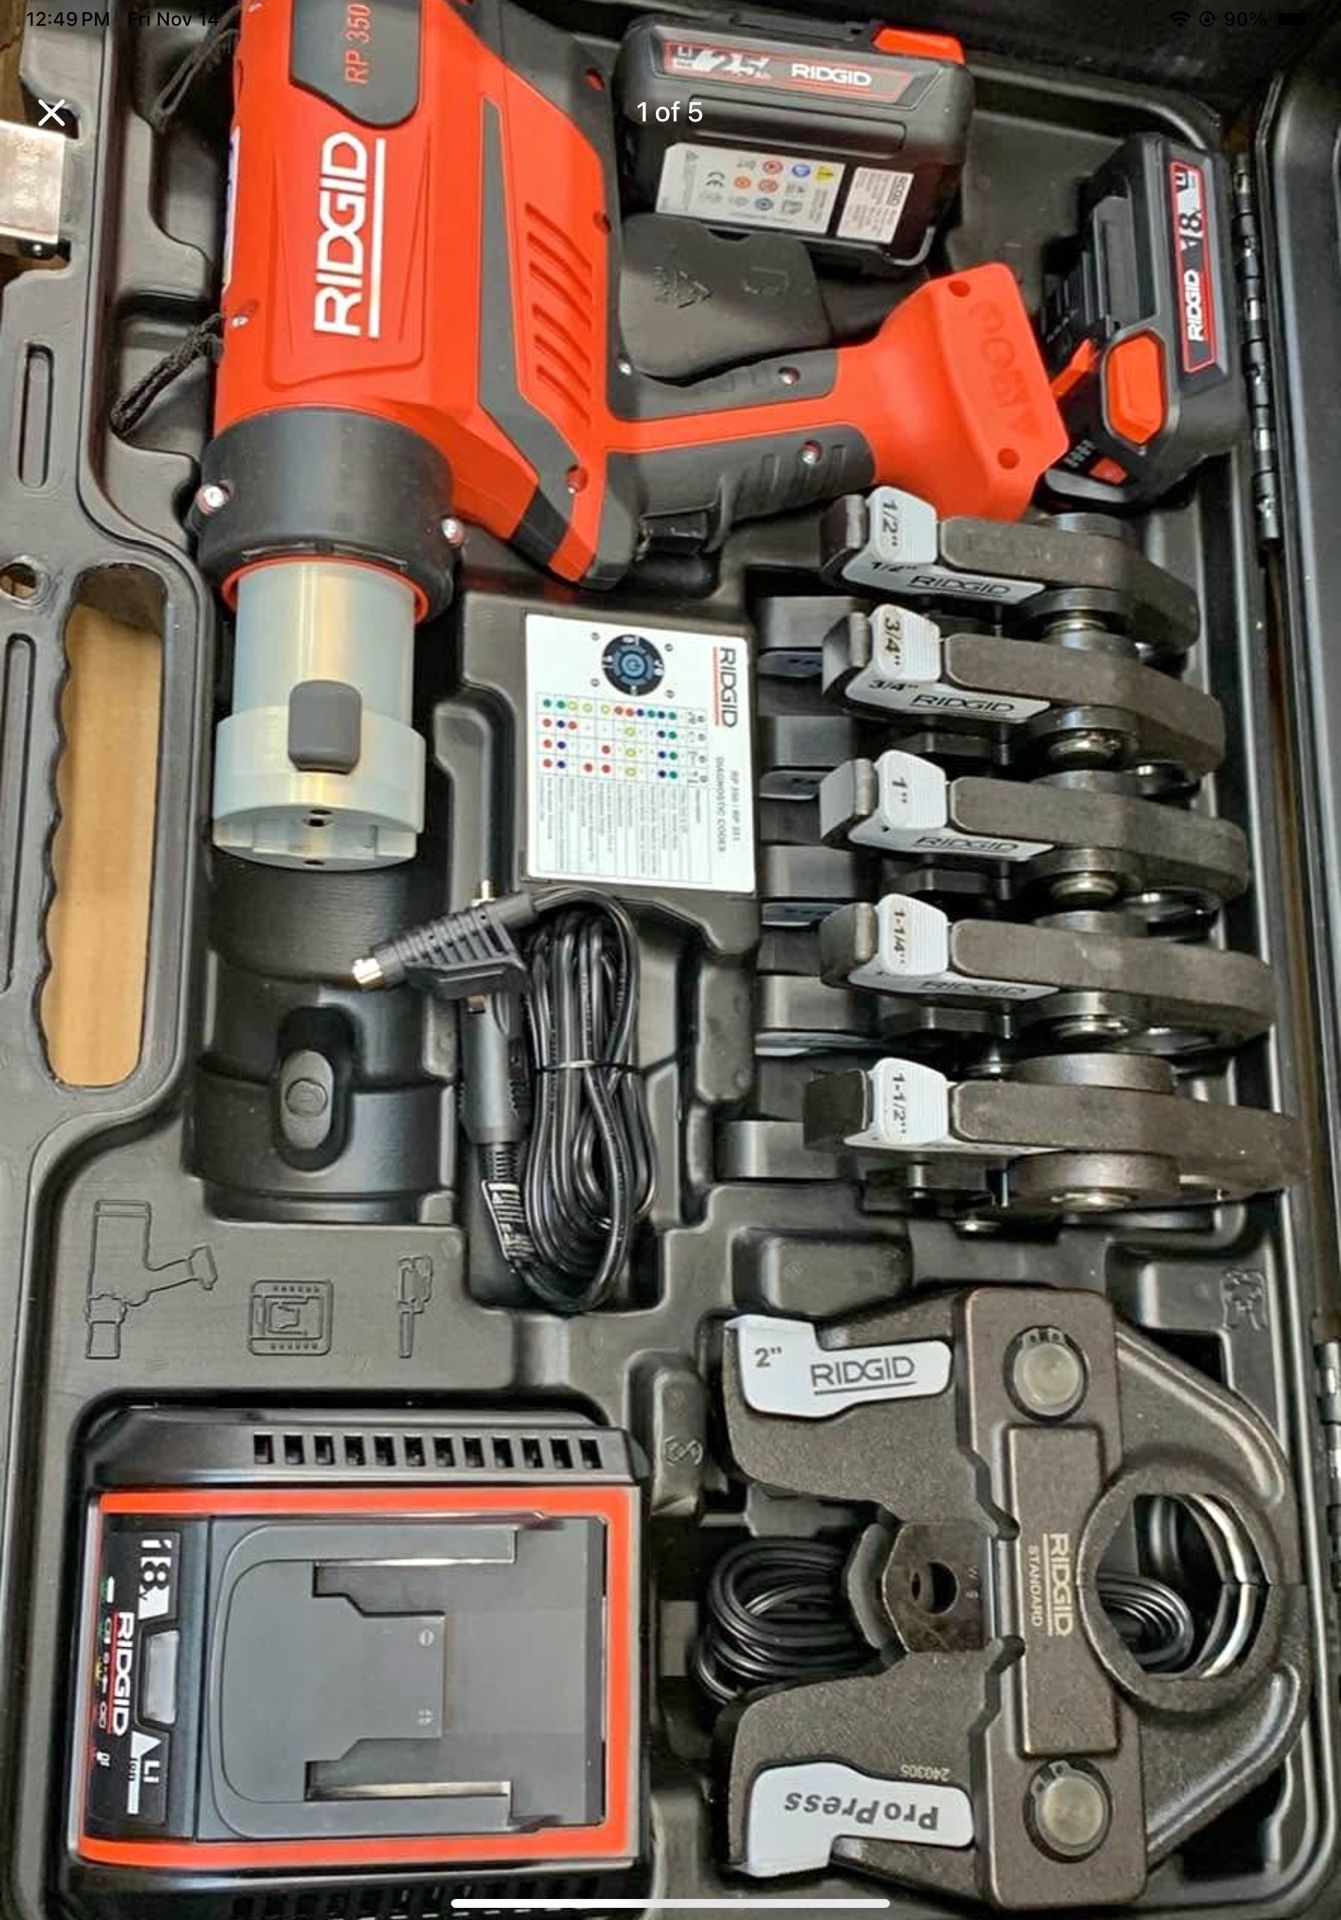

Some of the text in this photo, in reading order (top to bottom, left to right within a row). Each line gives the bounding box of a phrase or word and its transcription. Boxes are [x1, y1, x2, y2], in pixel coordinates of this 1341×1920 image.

[345, 3, 373, 85] RP 350
[791, 63, 872, 86] RIDGID
[313, 131, 368, 337] RIDGID
[1183, 269, 1204, 342] RIDGID
[881, 499, 899, 547] 1/2"
[910, 575, 1010, 595] RIDGID
[884, 617, 901, 666] 3/4"
[719, 647, 738, 728] RIDGID
[913, 694, 1015, 713] RIDGID
[892, 777, 909, 803] 1"
[916, 836, 1019, 850] RIDGID
[892, 1073, 907, 1134] 1-1/2"
[754, 1346, 782, 1368] 2"
[810, 1355, 916, 1388] RIDGID
[1028, 1544, 1044, 1627] STANDARD
[1050, 1533, 1074, 1637] RIDGID
[113, 1611, 134, 1736] RIDGID
